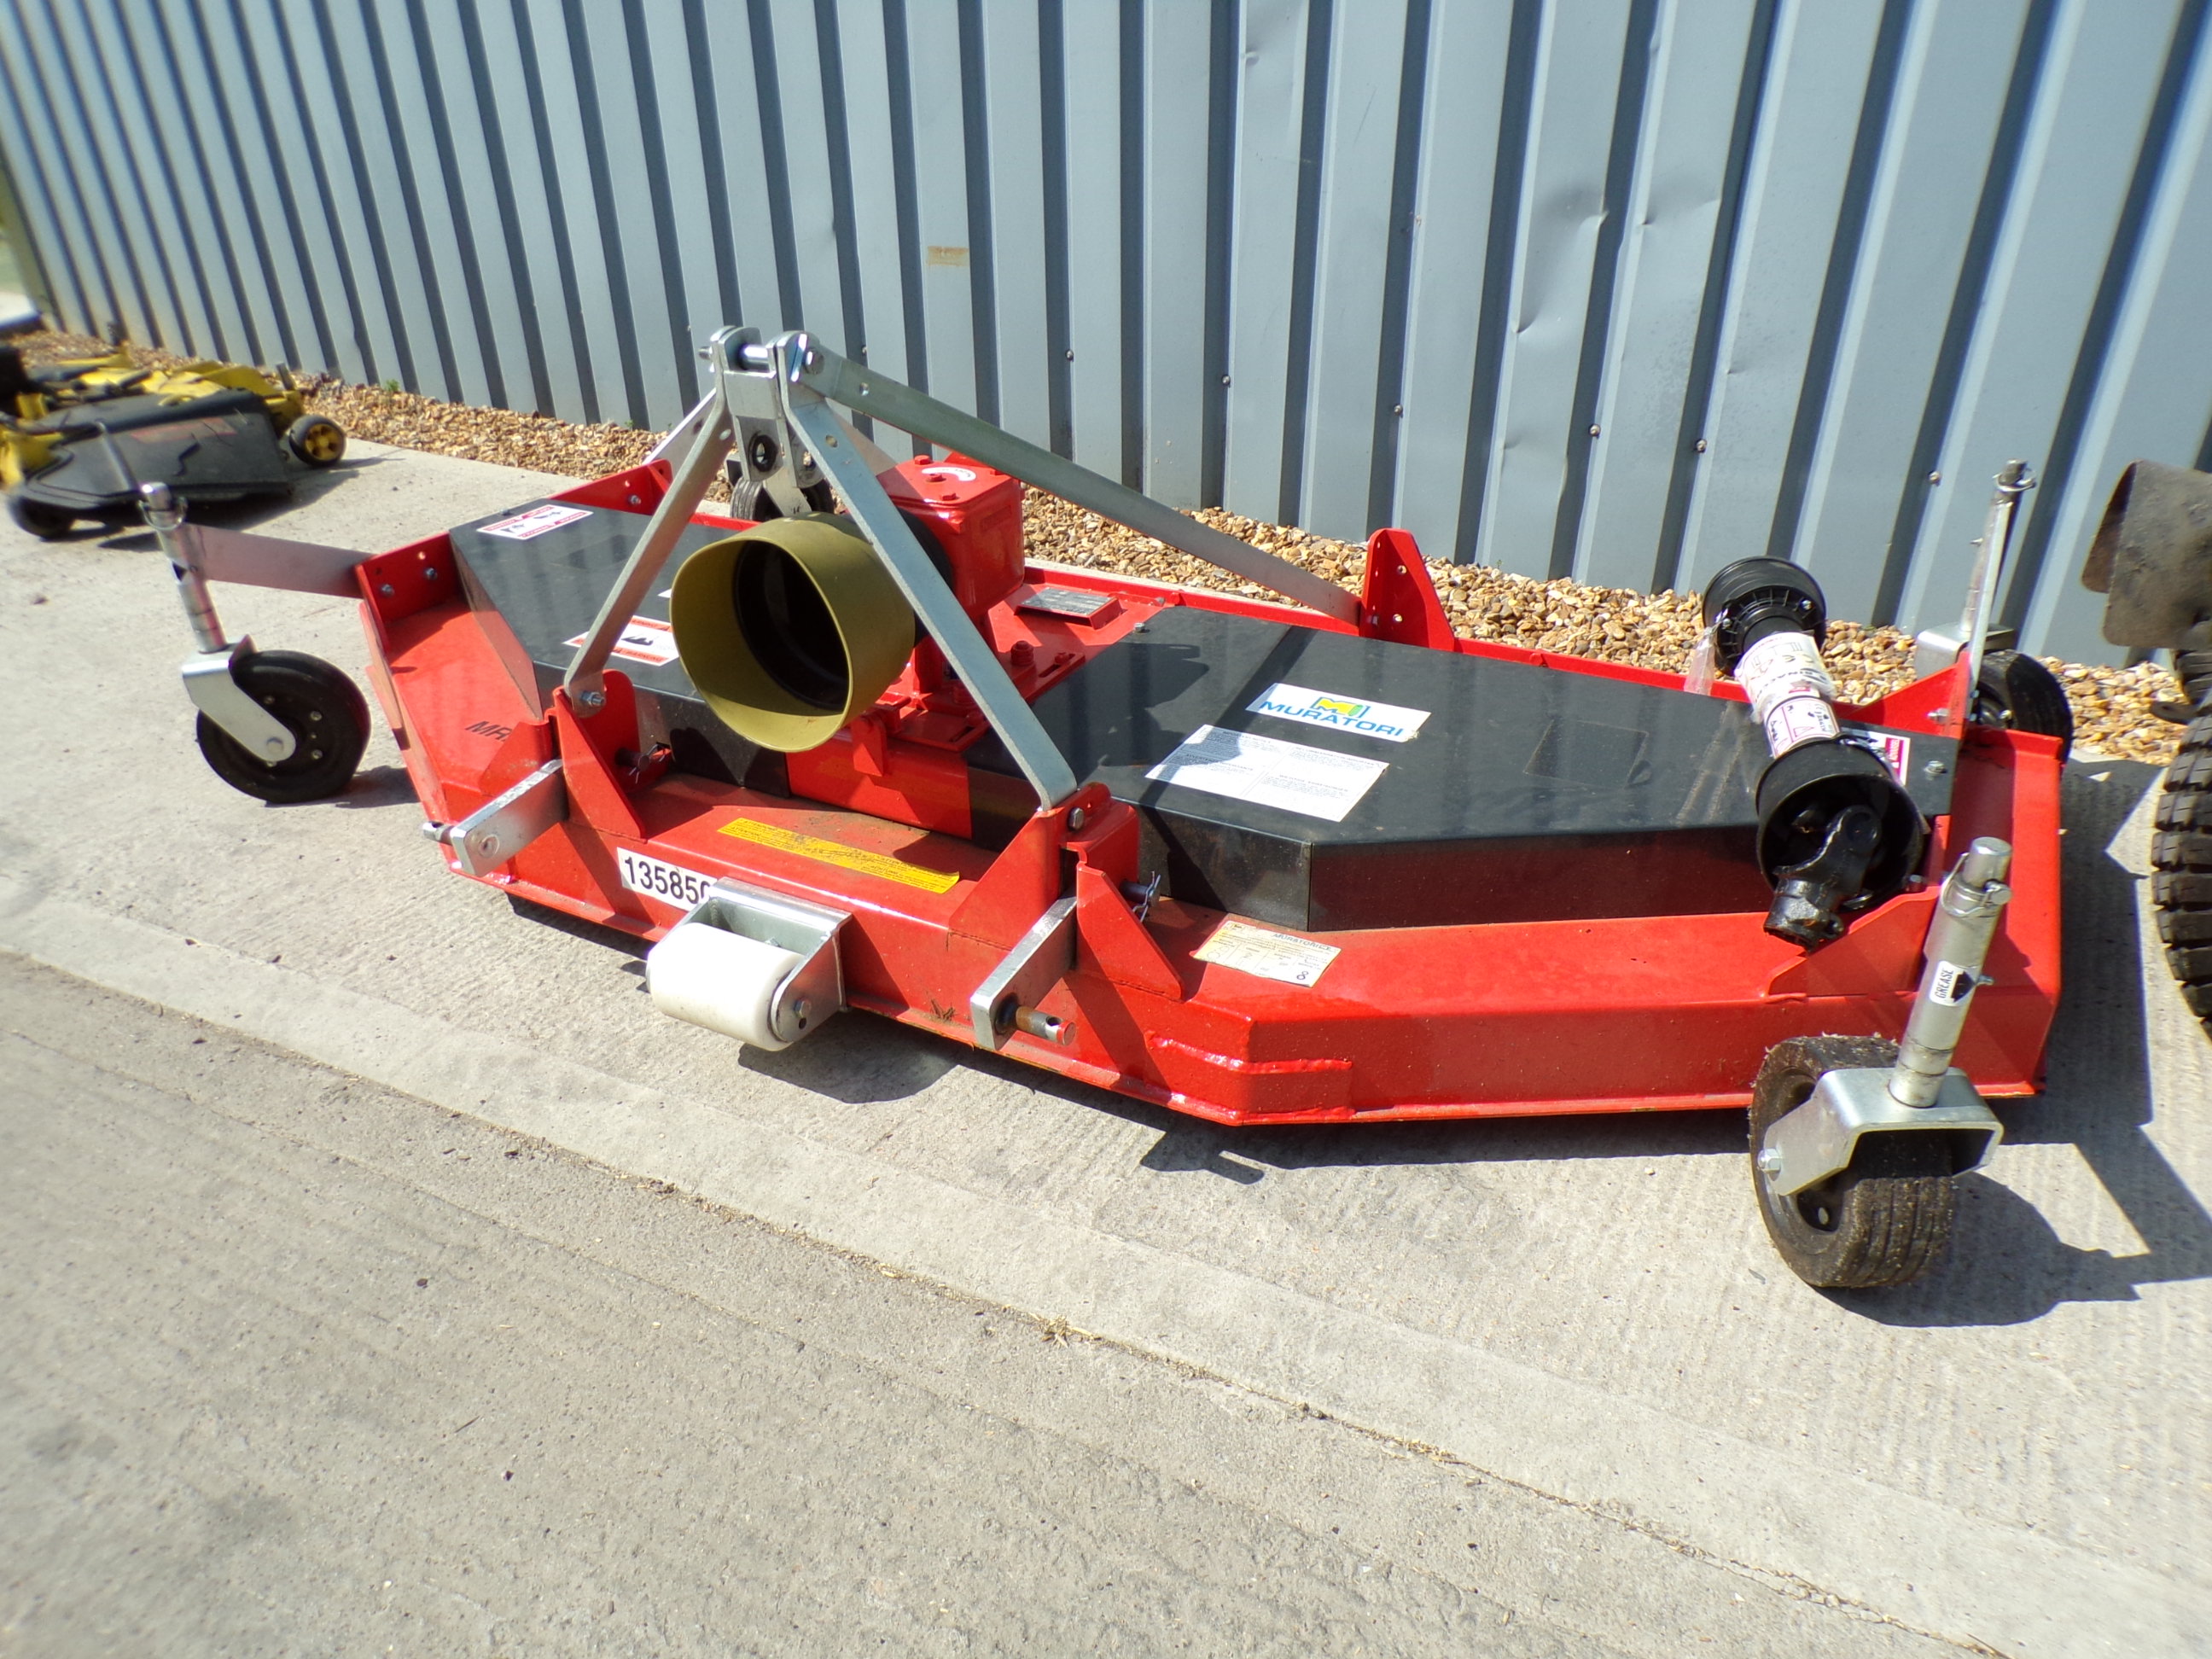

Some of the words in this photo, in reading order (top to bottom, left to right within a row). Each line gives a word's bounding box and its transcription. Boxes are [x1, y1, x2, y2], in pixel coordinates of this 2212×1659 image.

[1259, 701, 1405, 736] MURATORI
[1296, 970, 1309, 981] 8
[1934, 969, 1954, 998] GREASE
